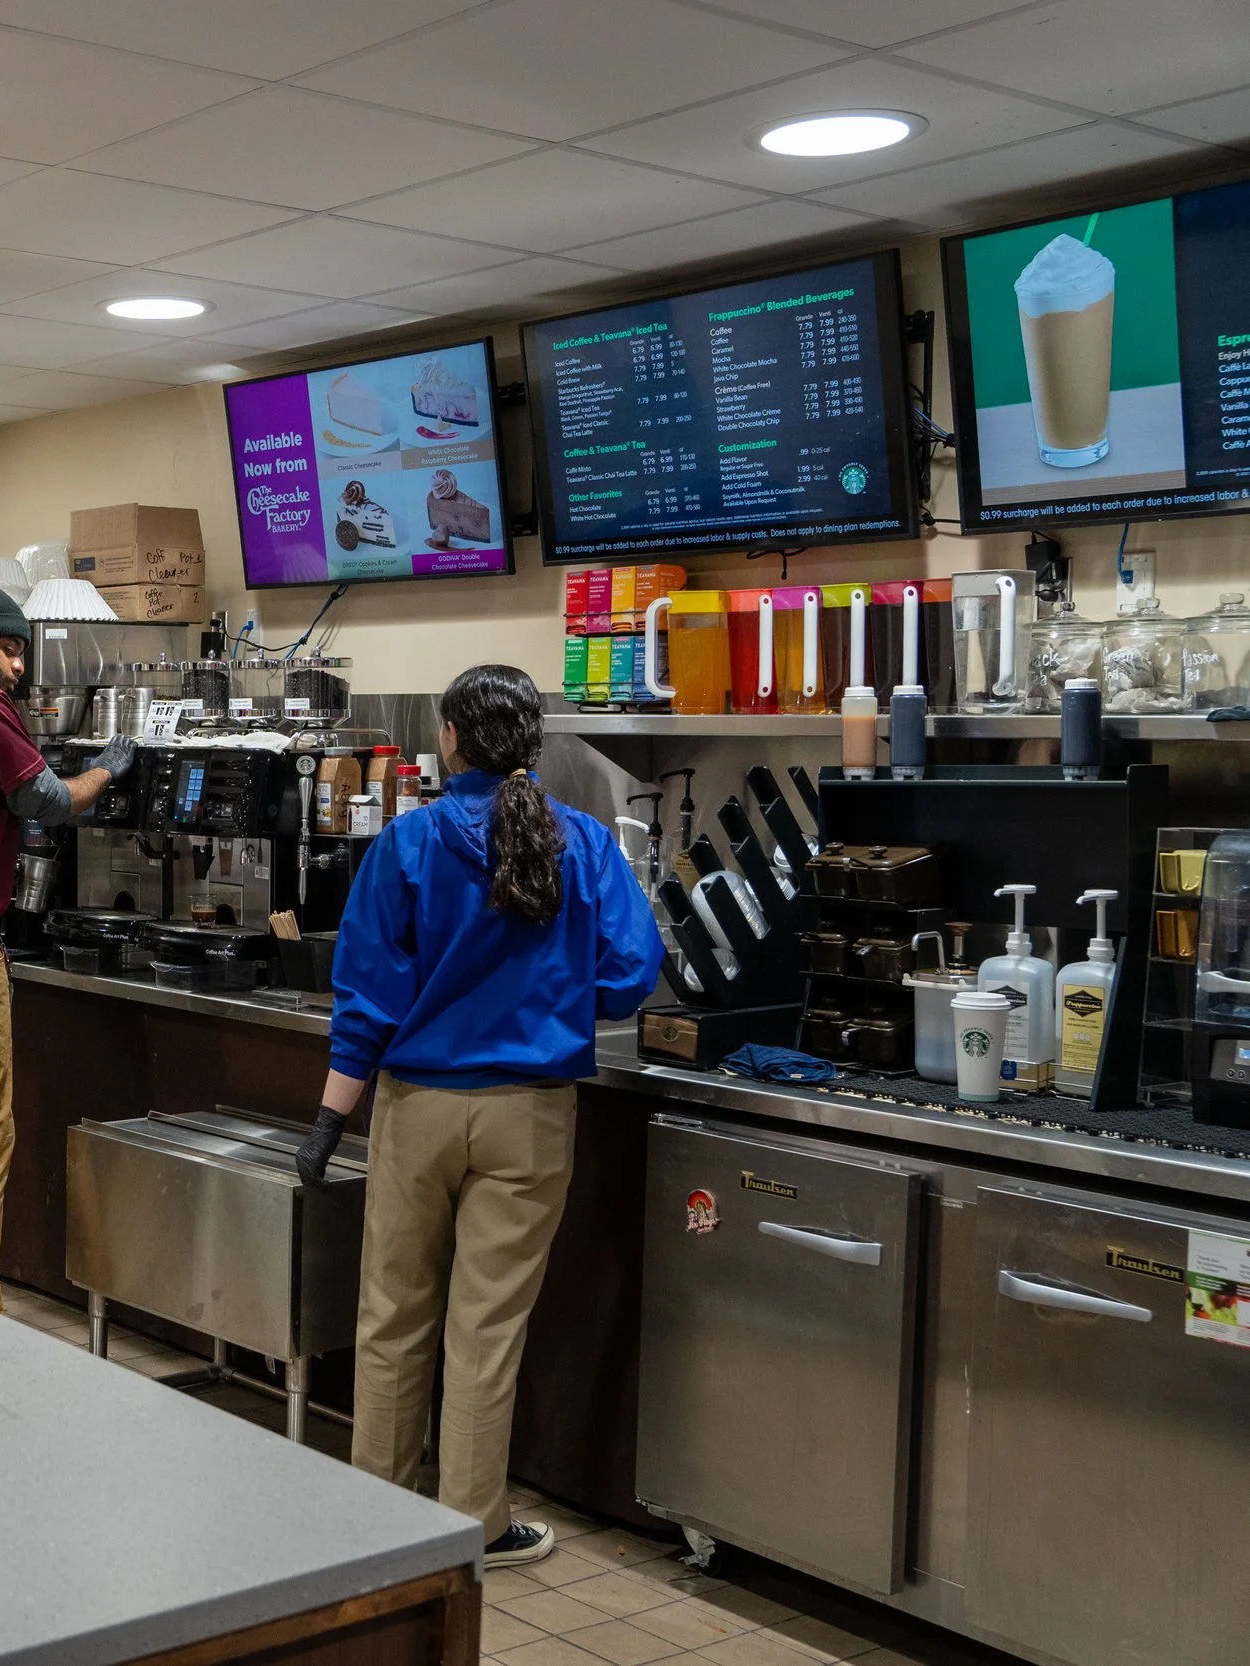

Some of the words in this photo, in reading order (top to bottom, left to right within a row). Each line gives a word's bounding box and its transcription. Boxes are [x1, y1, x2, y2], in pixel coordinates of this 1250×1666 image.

[766, 297, 804, 311] Blended
[805, 288, 855, 304] Beverages
[799, 322, 813, 330] 7.79
[553, 342, 568, 351] Iced
[570, 337, 592, 347] Coffee
[636, 325, 652, 335] Iced
[654, 323, 668, 332] Tea
[710, 327, 732, 337] Coffee
[712, 346, 734, 355] Caramel
[1218, 351, 1241, 361] Enjoy
[712, 356, 731, 364] Mocha
[713, 365, 729, 373] White
[730, 361, 757, 370] Chocolate
[758, 357, 777, 366] Mocha
[714, 375, 725, 383] Java
[716, 396, 733, 404] Vanilla
[717, 404, 746, 413] Strawberry
[1221, 401, 1248, 411] Vanilla
[717, 414, 734, 422] White
[734, 411, 761, 420] Chocolate
[806, 412, 820, 420] 7.79
[718, 423, 738, 431] Double
[1222, 427, 1247, 437] White
[244, 431, 302, 454] Available
[718, 439, 777, 453] Customization
[564, 448, 588, 458] Coffee
[589, 446, 595, 454] &
[632, 441, 646, 449] Tea
[244, 462, 272, 478] Now
[274, 457, 308, 474] from
[260, 485, 272, 494] The
[247, 486, 310, 515] Cheesecake
[568, 493, 589, 502] Other
[590, 490, 622, 500] Favorites
[980, 510, 1001, 520] $0.99
[1003, 508, 1038, 519] surcharge
[1040, 506, 1053, 515] will
[1055, 505, 1064, 514] be
[1067, 503, 1090, 513] added
[1092, 502, 1100, 512] to
[1102, 500, 1121, 510] each
[1123, 498, 1144, 508] order
[1146, 497, 1162, 507] due
[1164, 496, 1172, 505] to
[1174, 492, 1214, 504] increased
[1217, 490, 1238, 501] labor
[1241, 489, 1248, 498] &
[266, 504, 310, 531] Factory
[555, 546, 570, 554] $0.99
[636, 539, 649, 547] each
[683, 534, 709, 543] increased
[732, 532, 750, 541] supply
[771, 528, 785, 536] Does
[798, 526, 814, 536] apply
[823, 524, 842, 534] dining
[844, 522, 858, 531] plan
[860, 520, 901, 531] redemptions.
[147, 548, 166, 564] Coff
